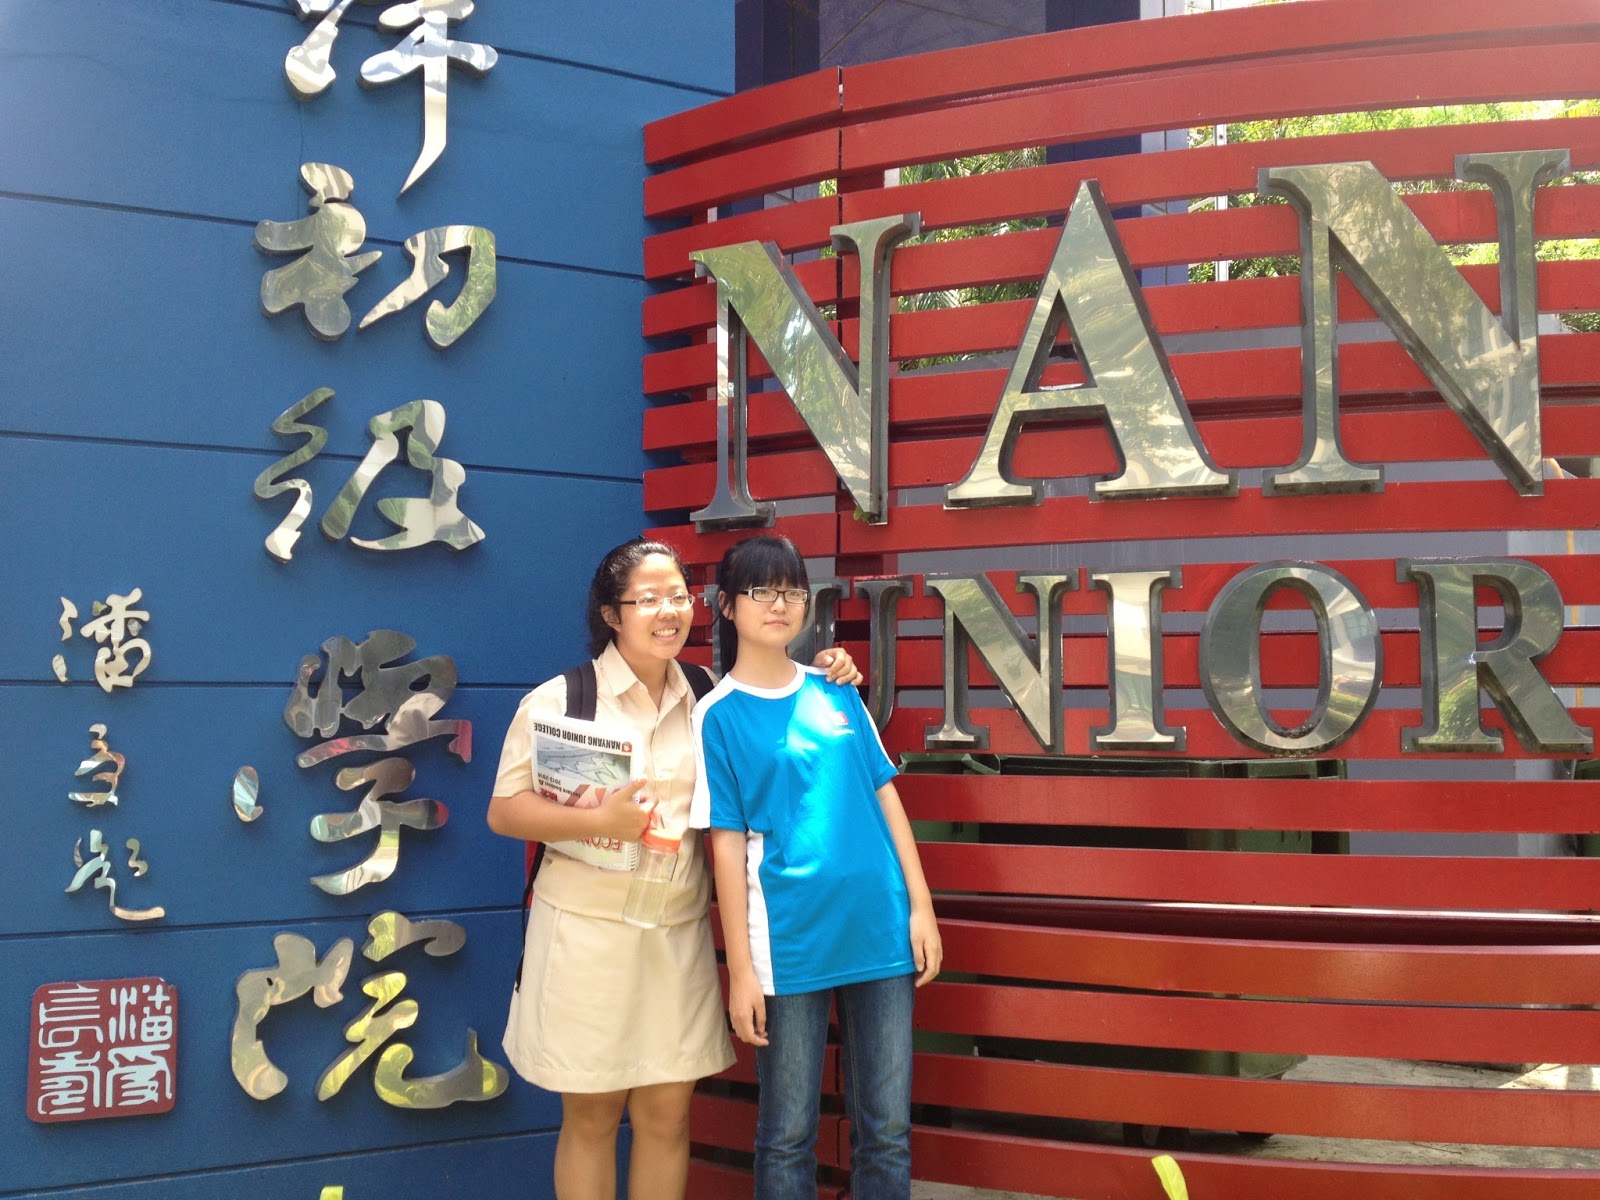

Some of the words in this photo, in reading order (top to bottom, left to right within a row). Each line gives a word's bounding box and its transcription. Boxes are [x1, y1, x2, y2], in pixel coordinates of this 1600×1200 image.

[689, 148, 1571, 533] NAN
[704, 557, 1594, 755] UNIOR
[534, 722, 561, 738] COLLEGE
[562, 730, 587, 745] JUNIOR
[588, 736, 621, 750] NANYANG
